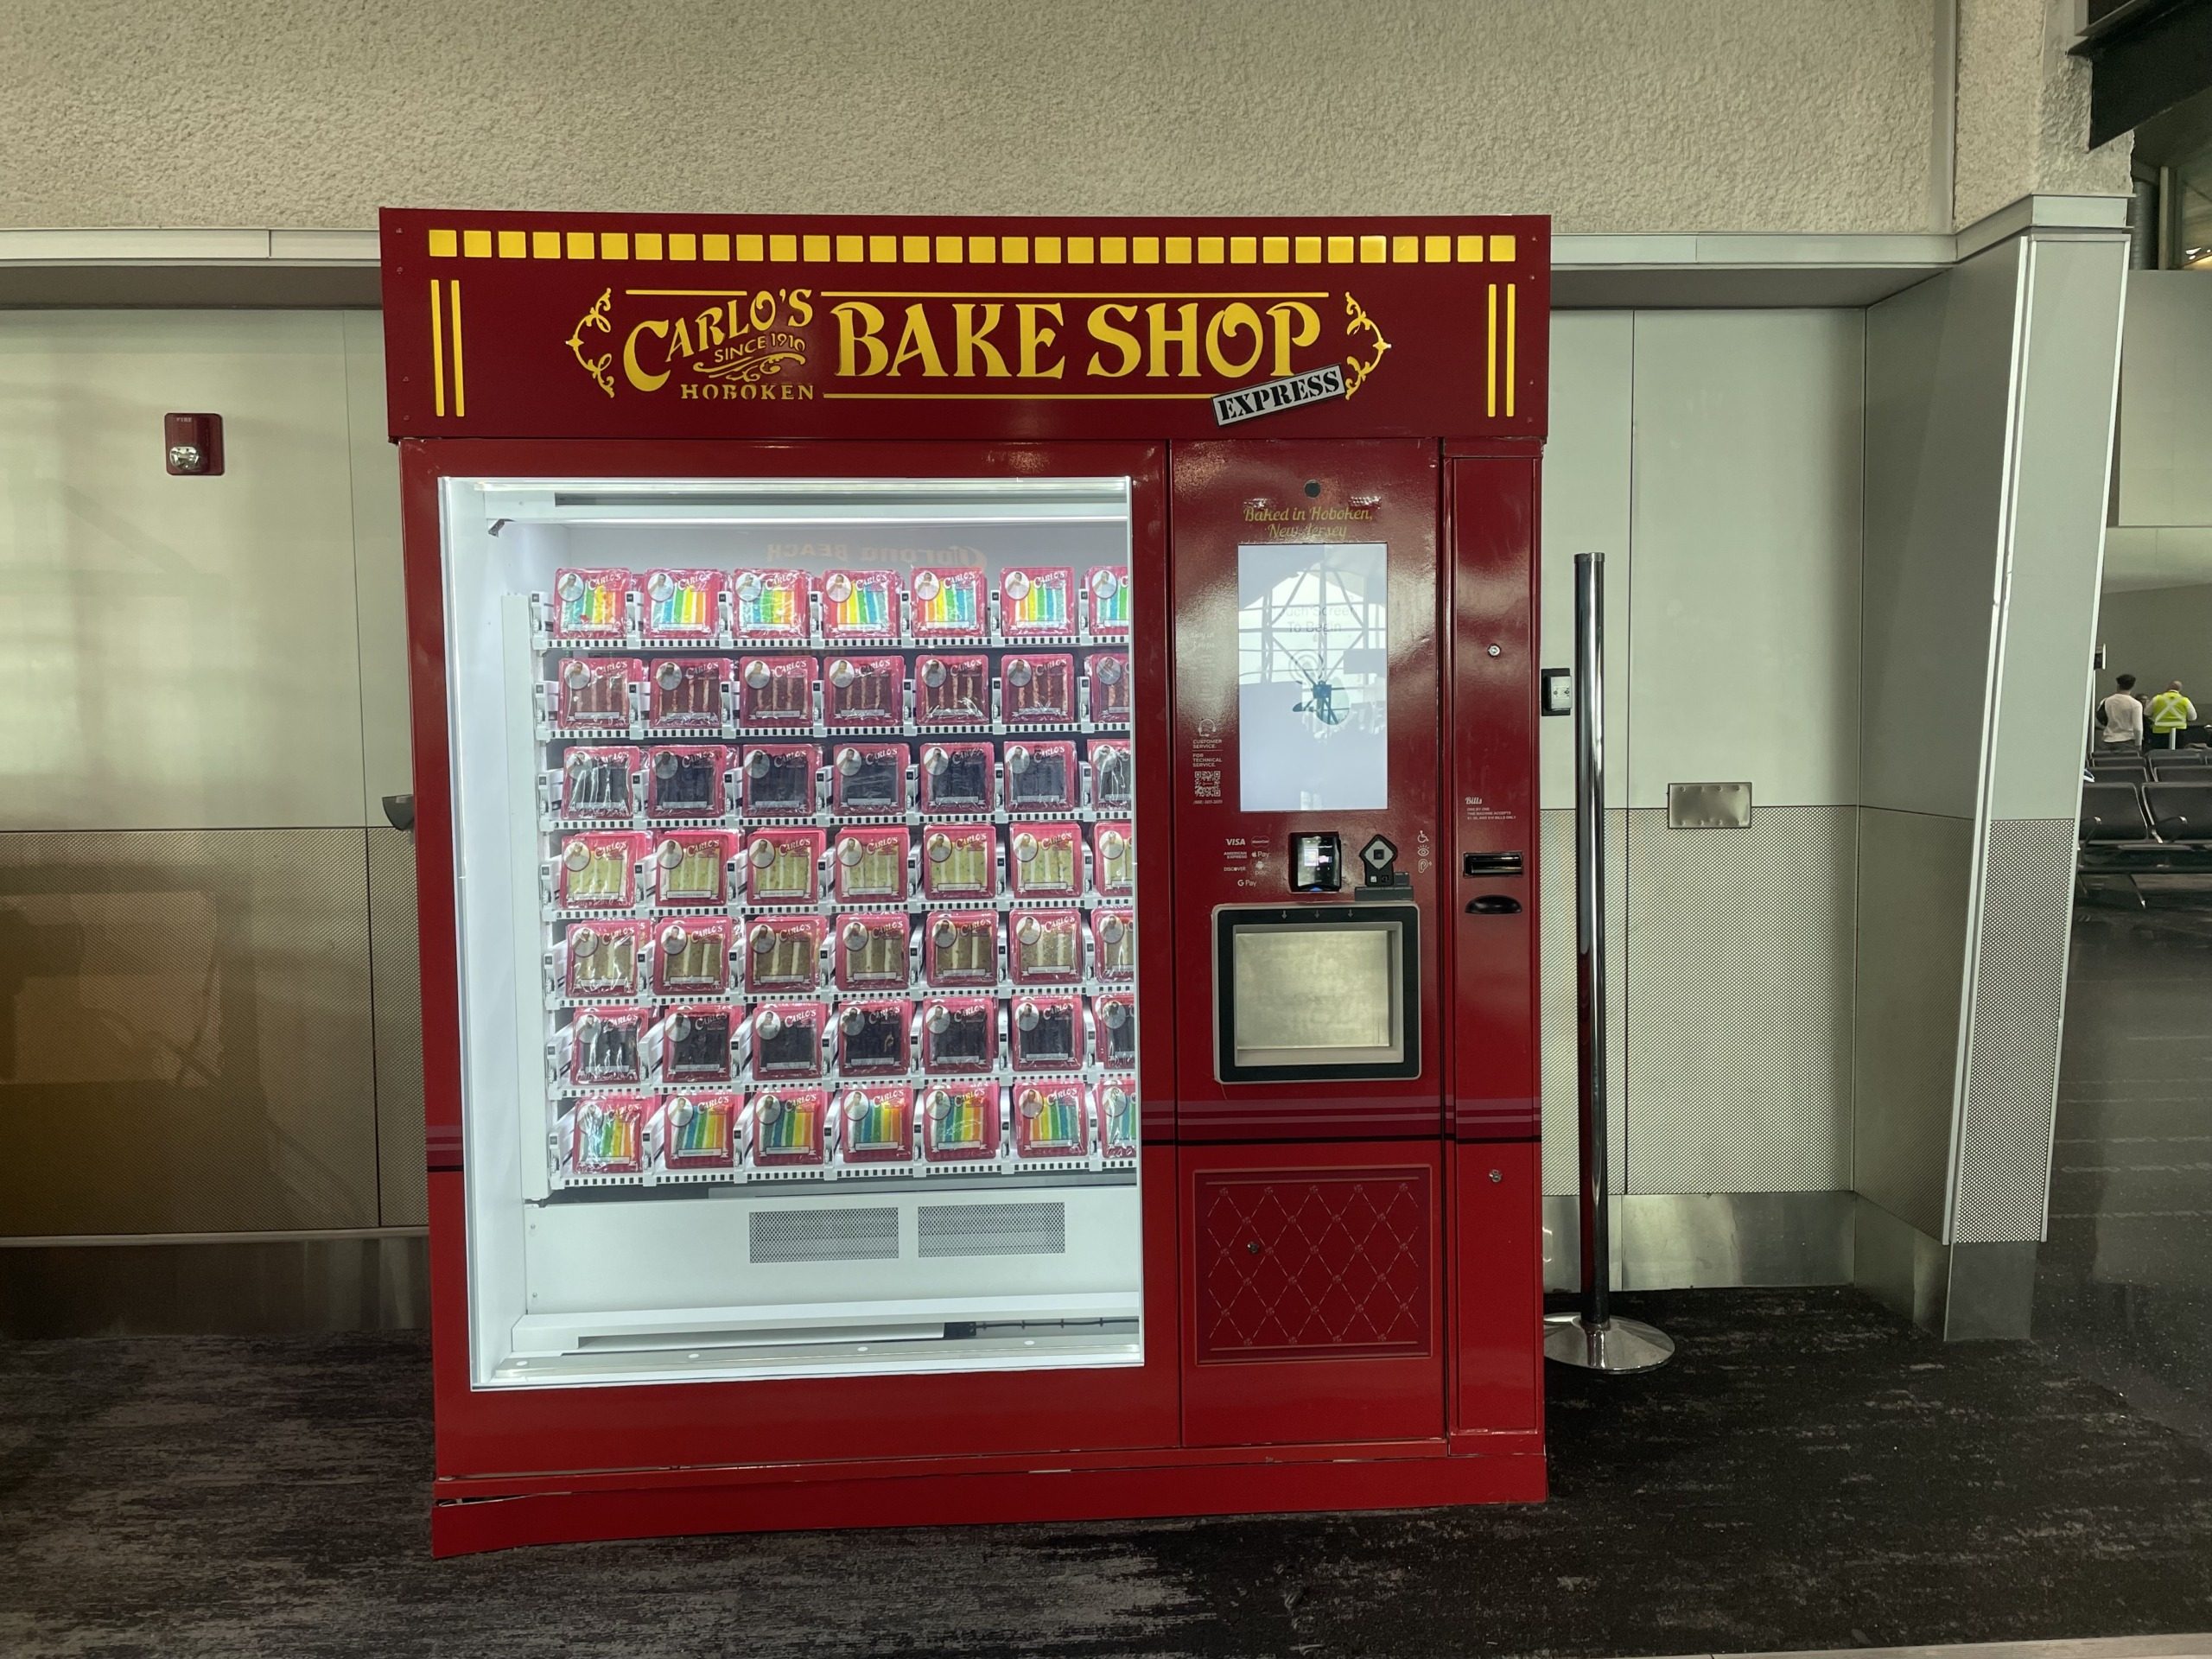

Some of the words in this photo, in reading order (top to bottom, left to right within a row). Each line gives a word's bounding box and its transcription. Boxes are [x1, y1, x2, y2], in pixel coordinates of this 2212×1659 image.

[623, 289, 814, 392] CARLO'S
[714, 335, 767, 364] SINCE
[770, 332, 806, 353] 1910
[831, 302, 1065, 378] BAKE
[1086, 301, 1322, 378] SHOP
[680, 383, 815, 401] HOBOKEN
[1217, 370, 1341, 422] EXPRESS
[1243, 505, 1289, 522] Baked
[1292, 507, 1306, 521] in
[1309, 505, 1373, 521] Hoboken,
[944, 571, 976, 589] CARLO'S
[1033, 571, 1065, 588] CARLO'S
[775, 660, 807, 677] CARLO'S
[866, 747, 897, 765] CARLO'S
[1033, 747, 1065, 763] CARLO'S
[687, 839, 719, 857] CARLO'S
[779, 838, 810, 856] CARLO'S
[867, 836, 899, 855] CARLO'S
[955, 833, 987, 850] CARLO'S
[1245, 879, 1257, 887] Pay
[960, 918, 991, 937] CARLO'S
[1044, 916, 1075, 932] CARLO'S
[691, 925, 723, 943] CARLO'S
[779, 924, 810, 943] CARLO'S
[785, 1009, 816, 1027] CARLO'S
[697, 1096, 729, 1114] CARLO'S
[873, 1090, 904, 1109] CARLO'S
[1046, 1087, 1077, 1106] CARLO'S
